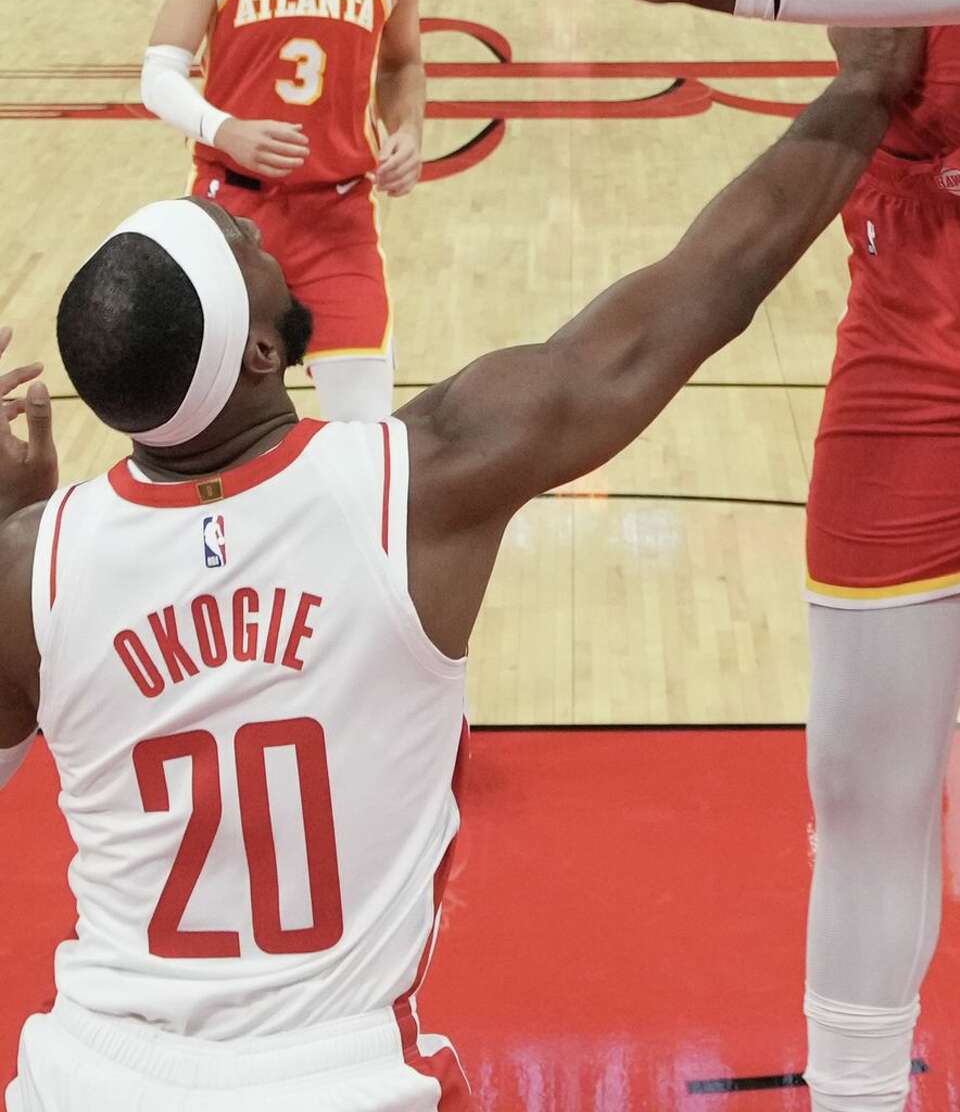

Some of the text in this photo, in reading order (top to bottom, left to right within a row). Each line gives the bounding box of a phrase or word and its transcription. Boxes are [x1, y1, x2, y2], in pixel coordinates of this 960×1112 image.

[274, 37, 328, 106] 3
[113, 587, 323, 699] OKOGIE
[132, 716, 344, 959] 20
